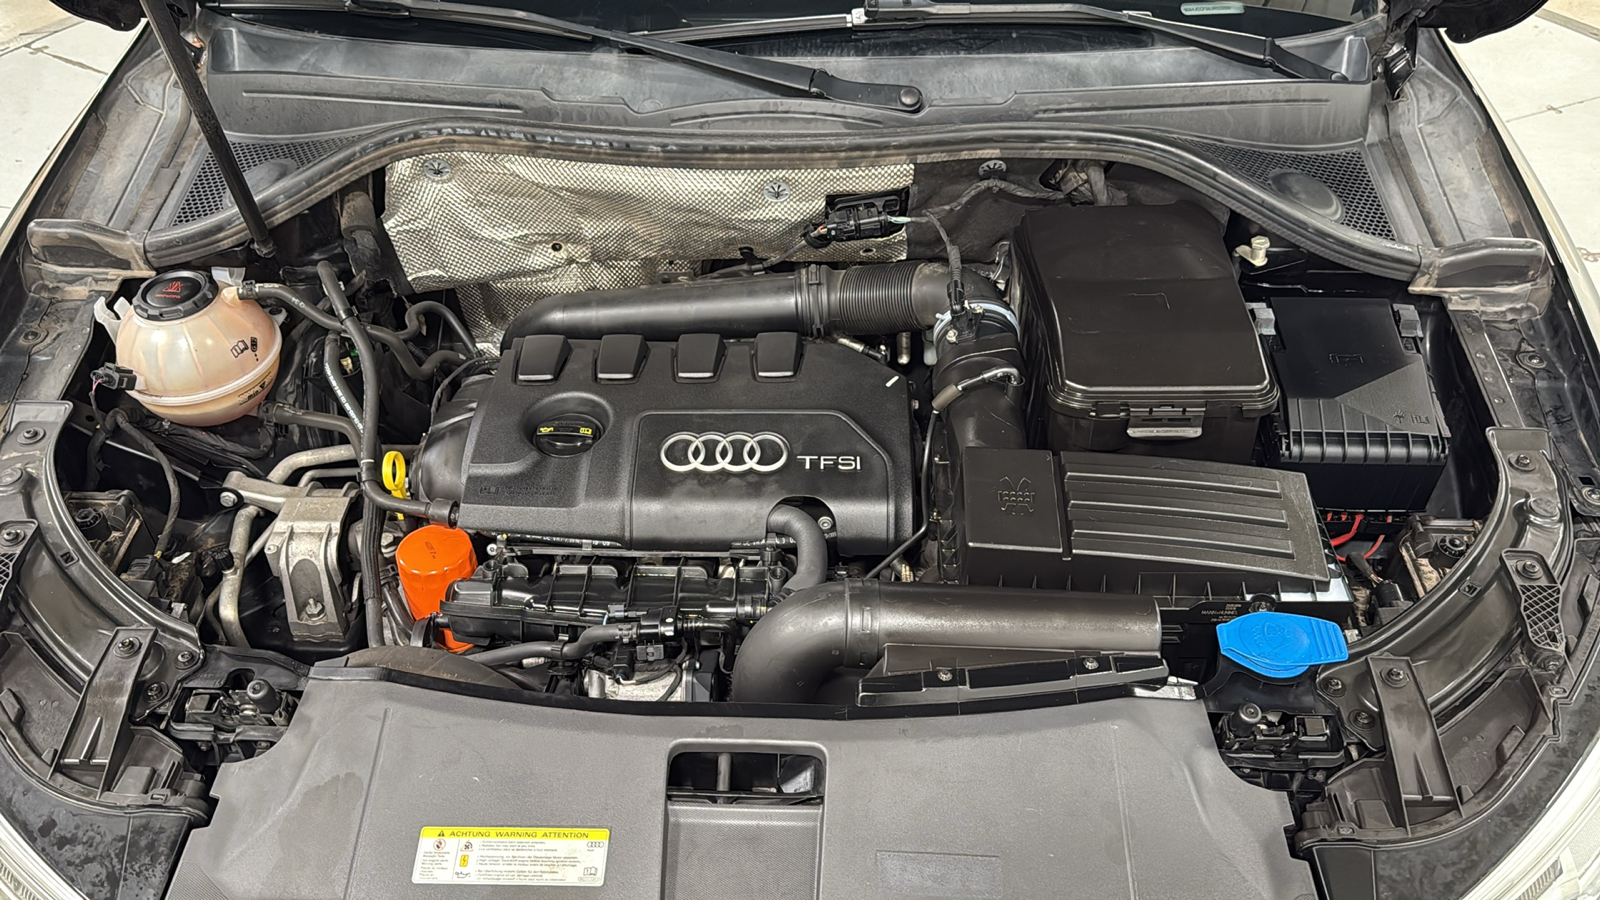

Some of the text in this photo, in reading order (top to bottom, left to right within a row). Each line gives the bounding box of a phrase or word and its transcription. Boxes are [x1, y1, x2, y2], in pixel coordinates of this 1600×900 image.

[247, 390, 259, 400] min
[796, 455, 862, 471] TFSI
[449, 830, 491, 838] ACHTUNG
[541, 831, 590, 839] ATTENTION
